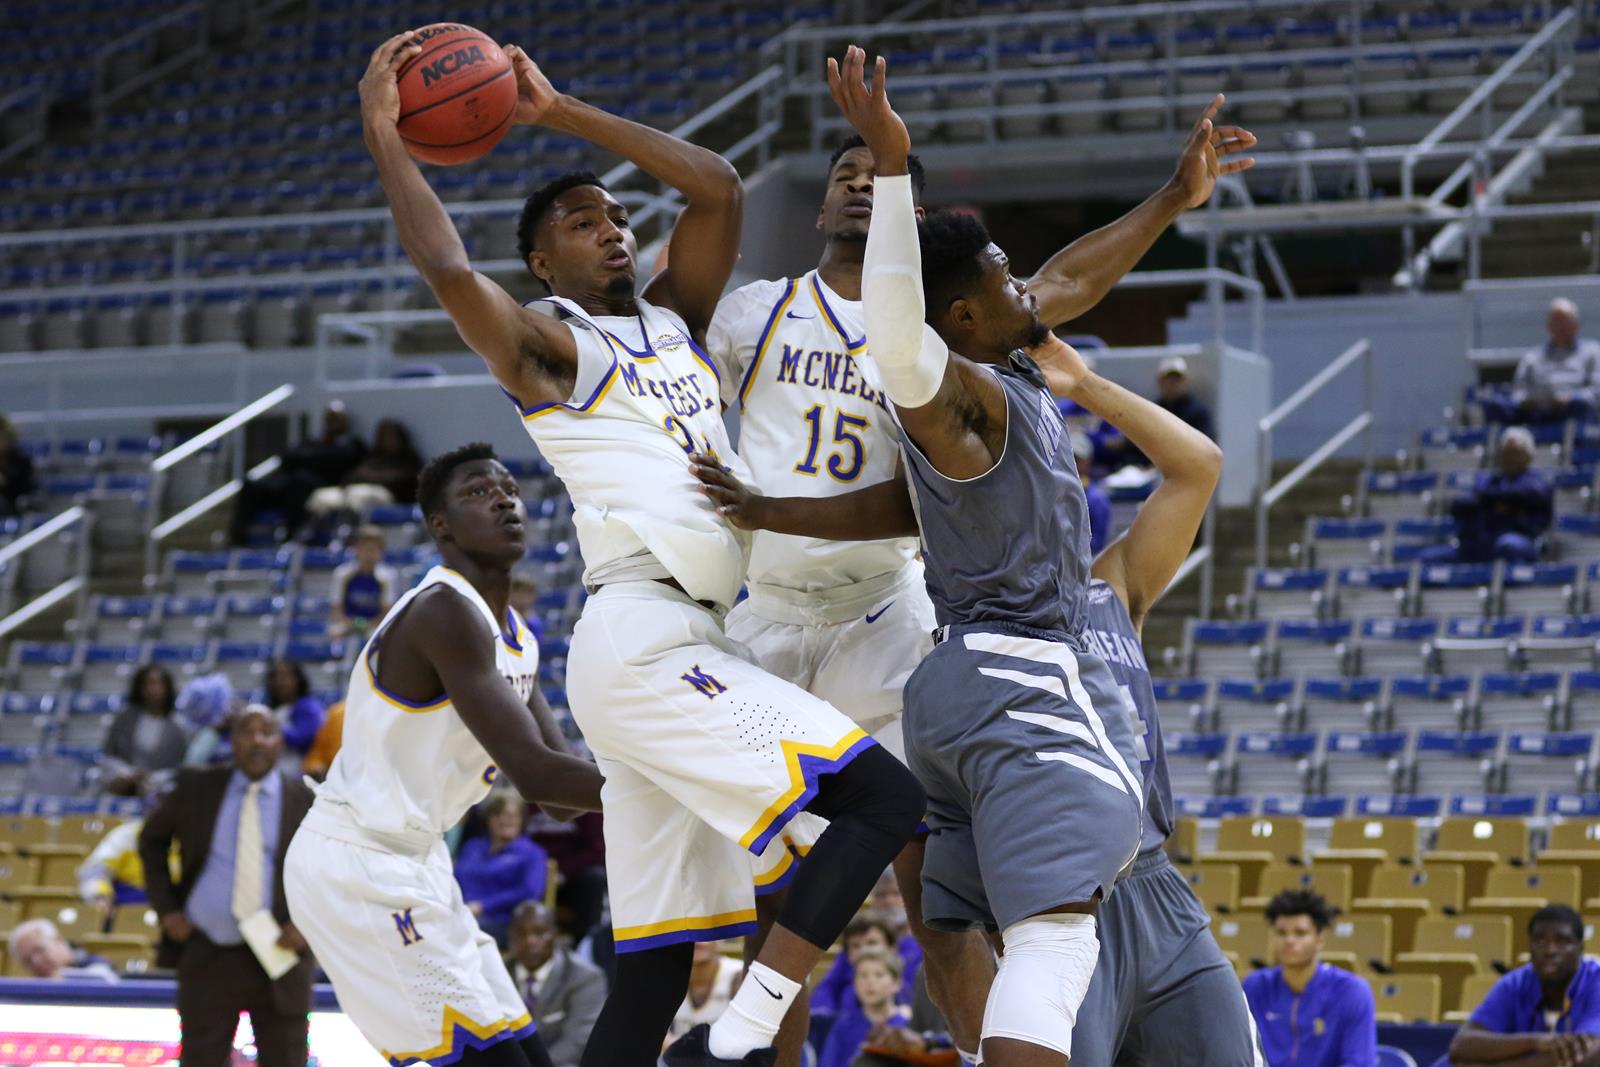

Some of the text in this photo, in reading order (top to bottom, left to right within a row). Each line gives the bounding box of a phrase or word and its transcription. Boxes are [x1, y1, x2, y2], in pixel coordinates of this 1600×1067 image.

[420, 46, 486, 87] NCAA
[793, 402, 871, 484] 15
[680, 664, 728, 700] M
[391, 907, 424, 946] M
